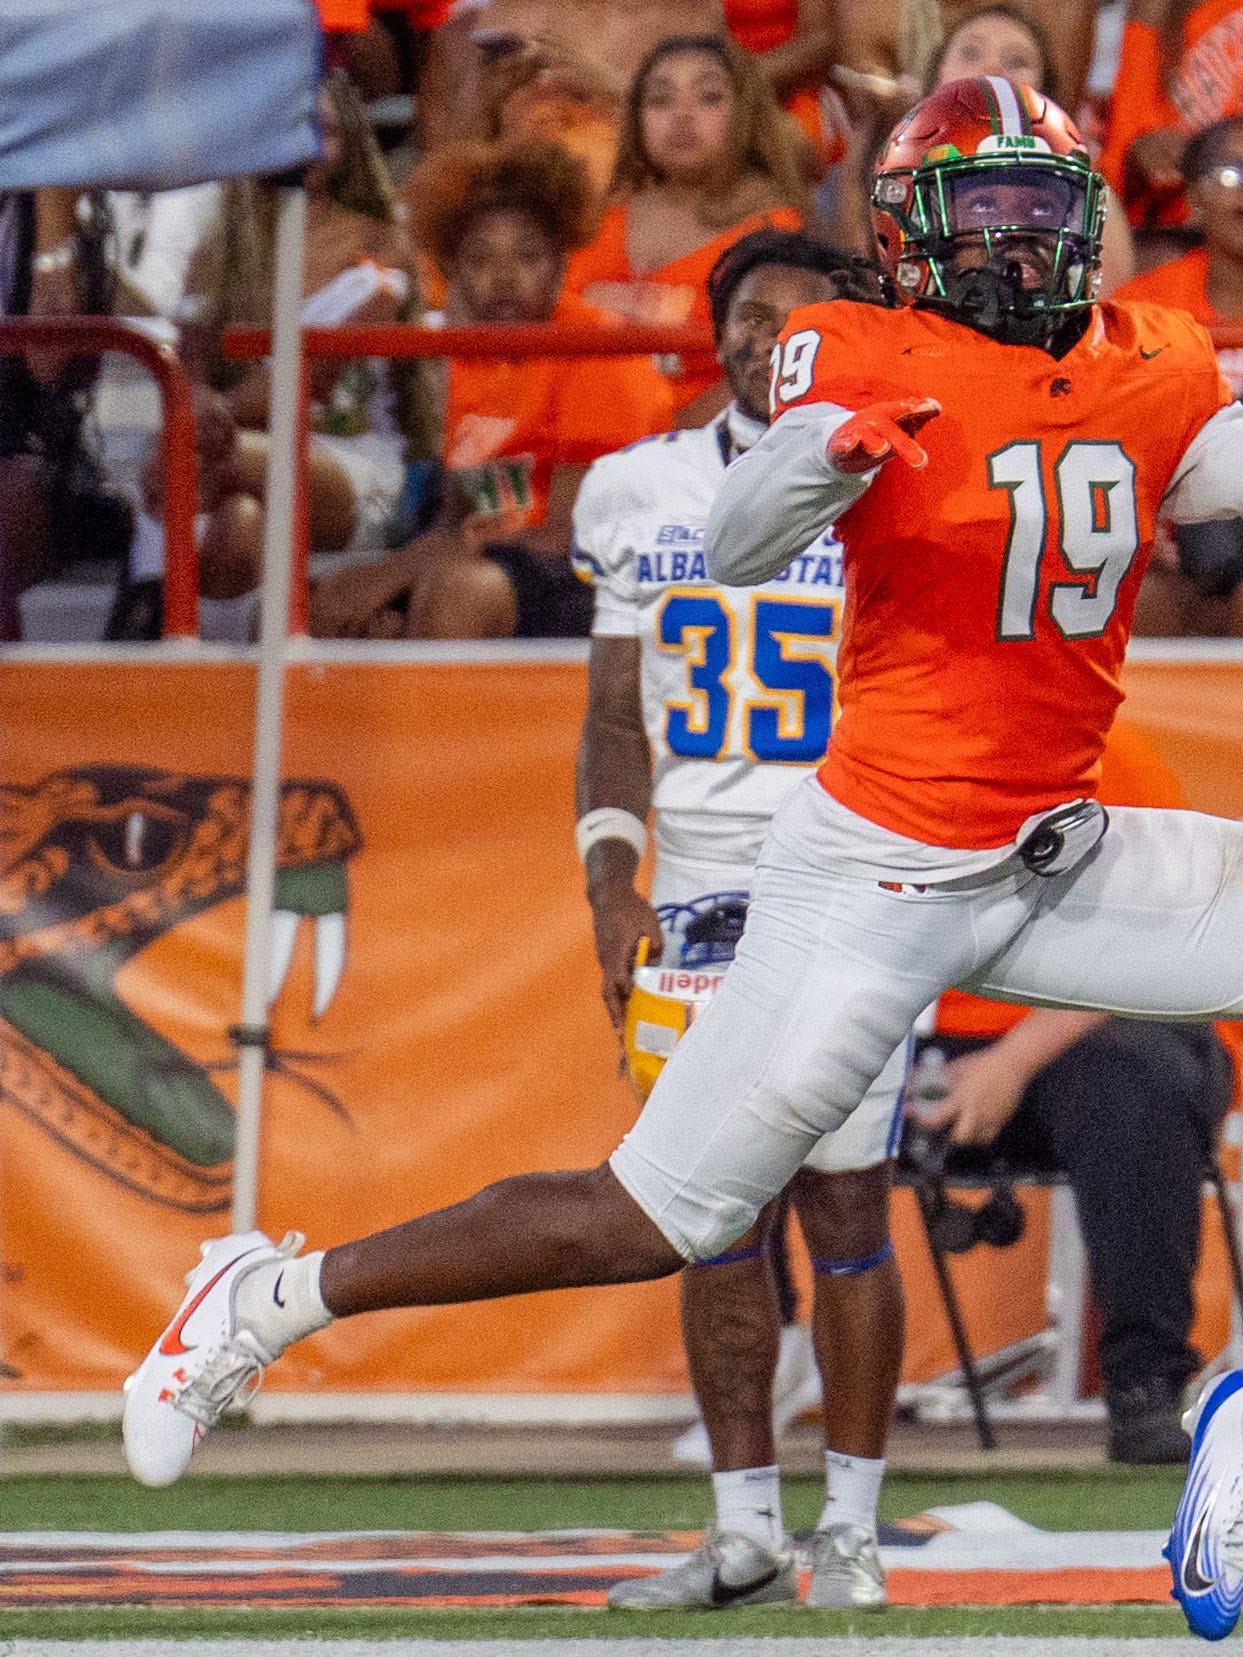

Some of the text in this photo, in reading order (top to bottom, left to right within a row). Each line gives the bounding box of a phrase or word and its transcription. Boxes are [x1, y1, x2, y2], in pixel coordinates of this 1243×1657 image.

[997, 136, 1036, 149] FAMU
[769, 327, 823, 415] 19
[637, 551, 707, 583] ALBA
[986, 439, 1139, 643] 19
[656, 585, 843, 768] 35
